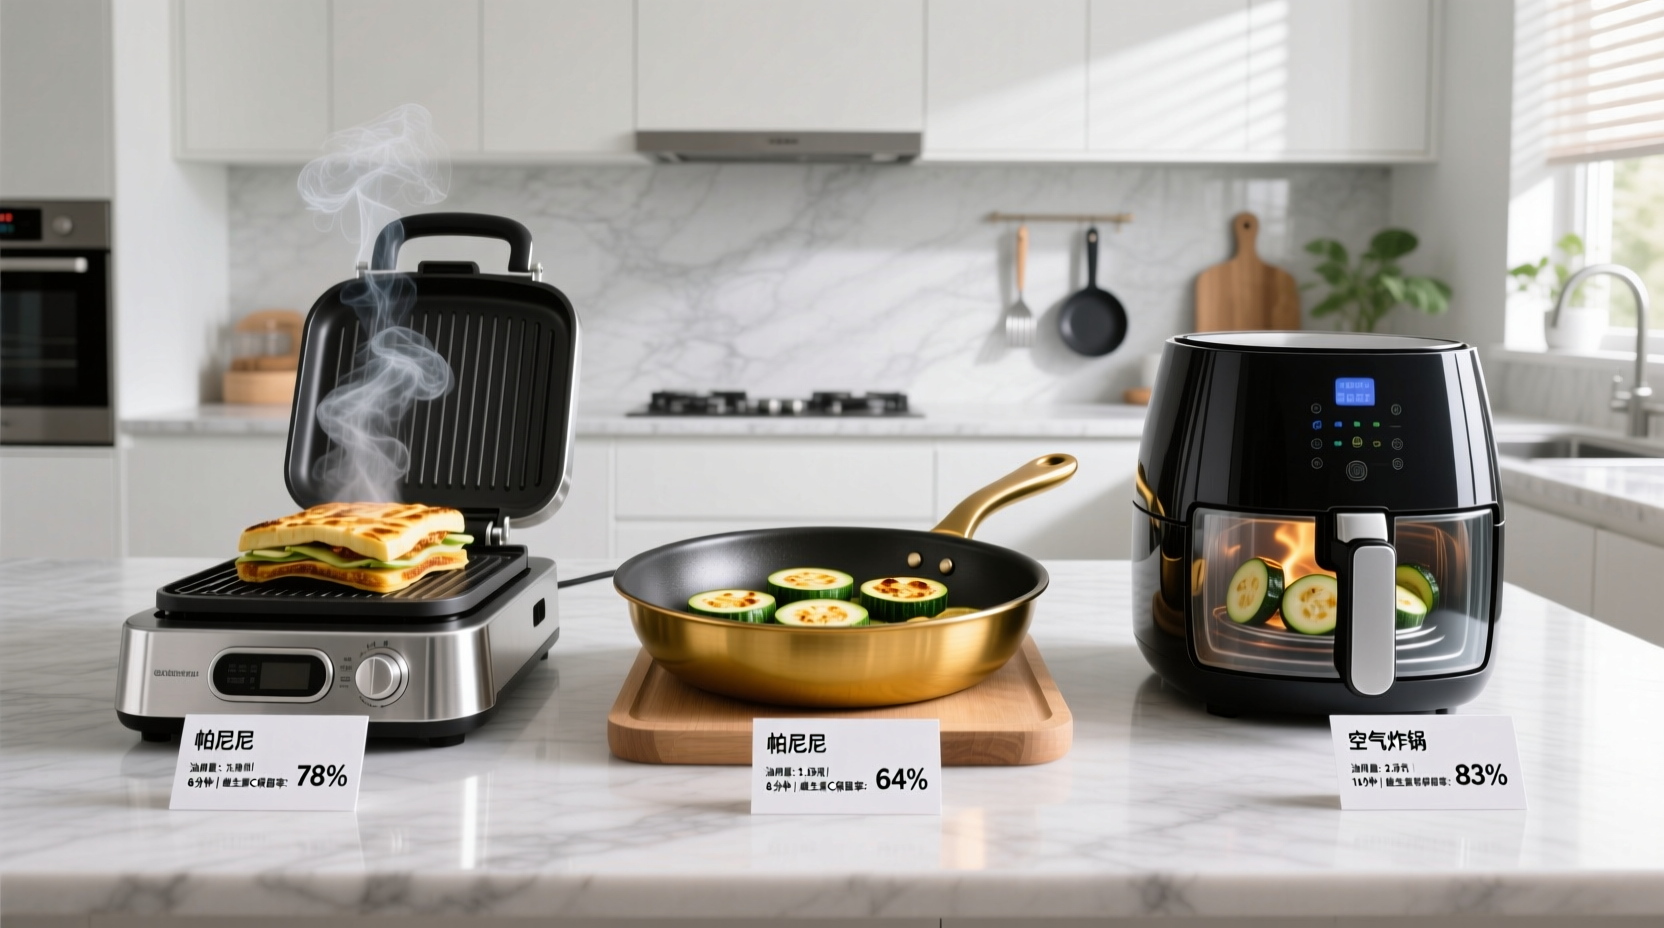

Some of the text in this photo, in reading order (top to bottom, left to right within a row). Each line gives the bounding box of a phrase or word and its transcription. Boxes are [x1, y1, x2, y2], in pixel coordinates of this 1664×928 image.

[194, 729, 254, 751] 帕尼尼
[767, 732, 827, 754] 帕尼尼
[1348, 730, 1427, 751] 空气炸锅
[297, 764, 348, 787] 78%
[876, 767, 928, 791] 64%
[1455, 763, 1508, 786] 83%
